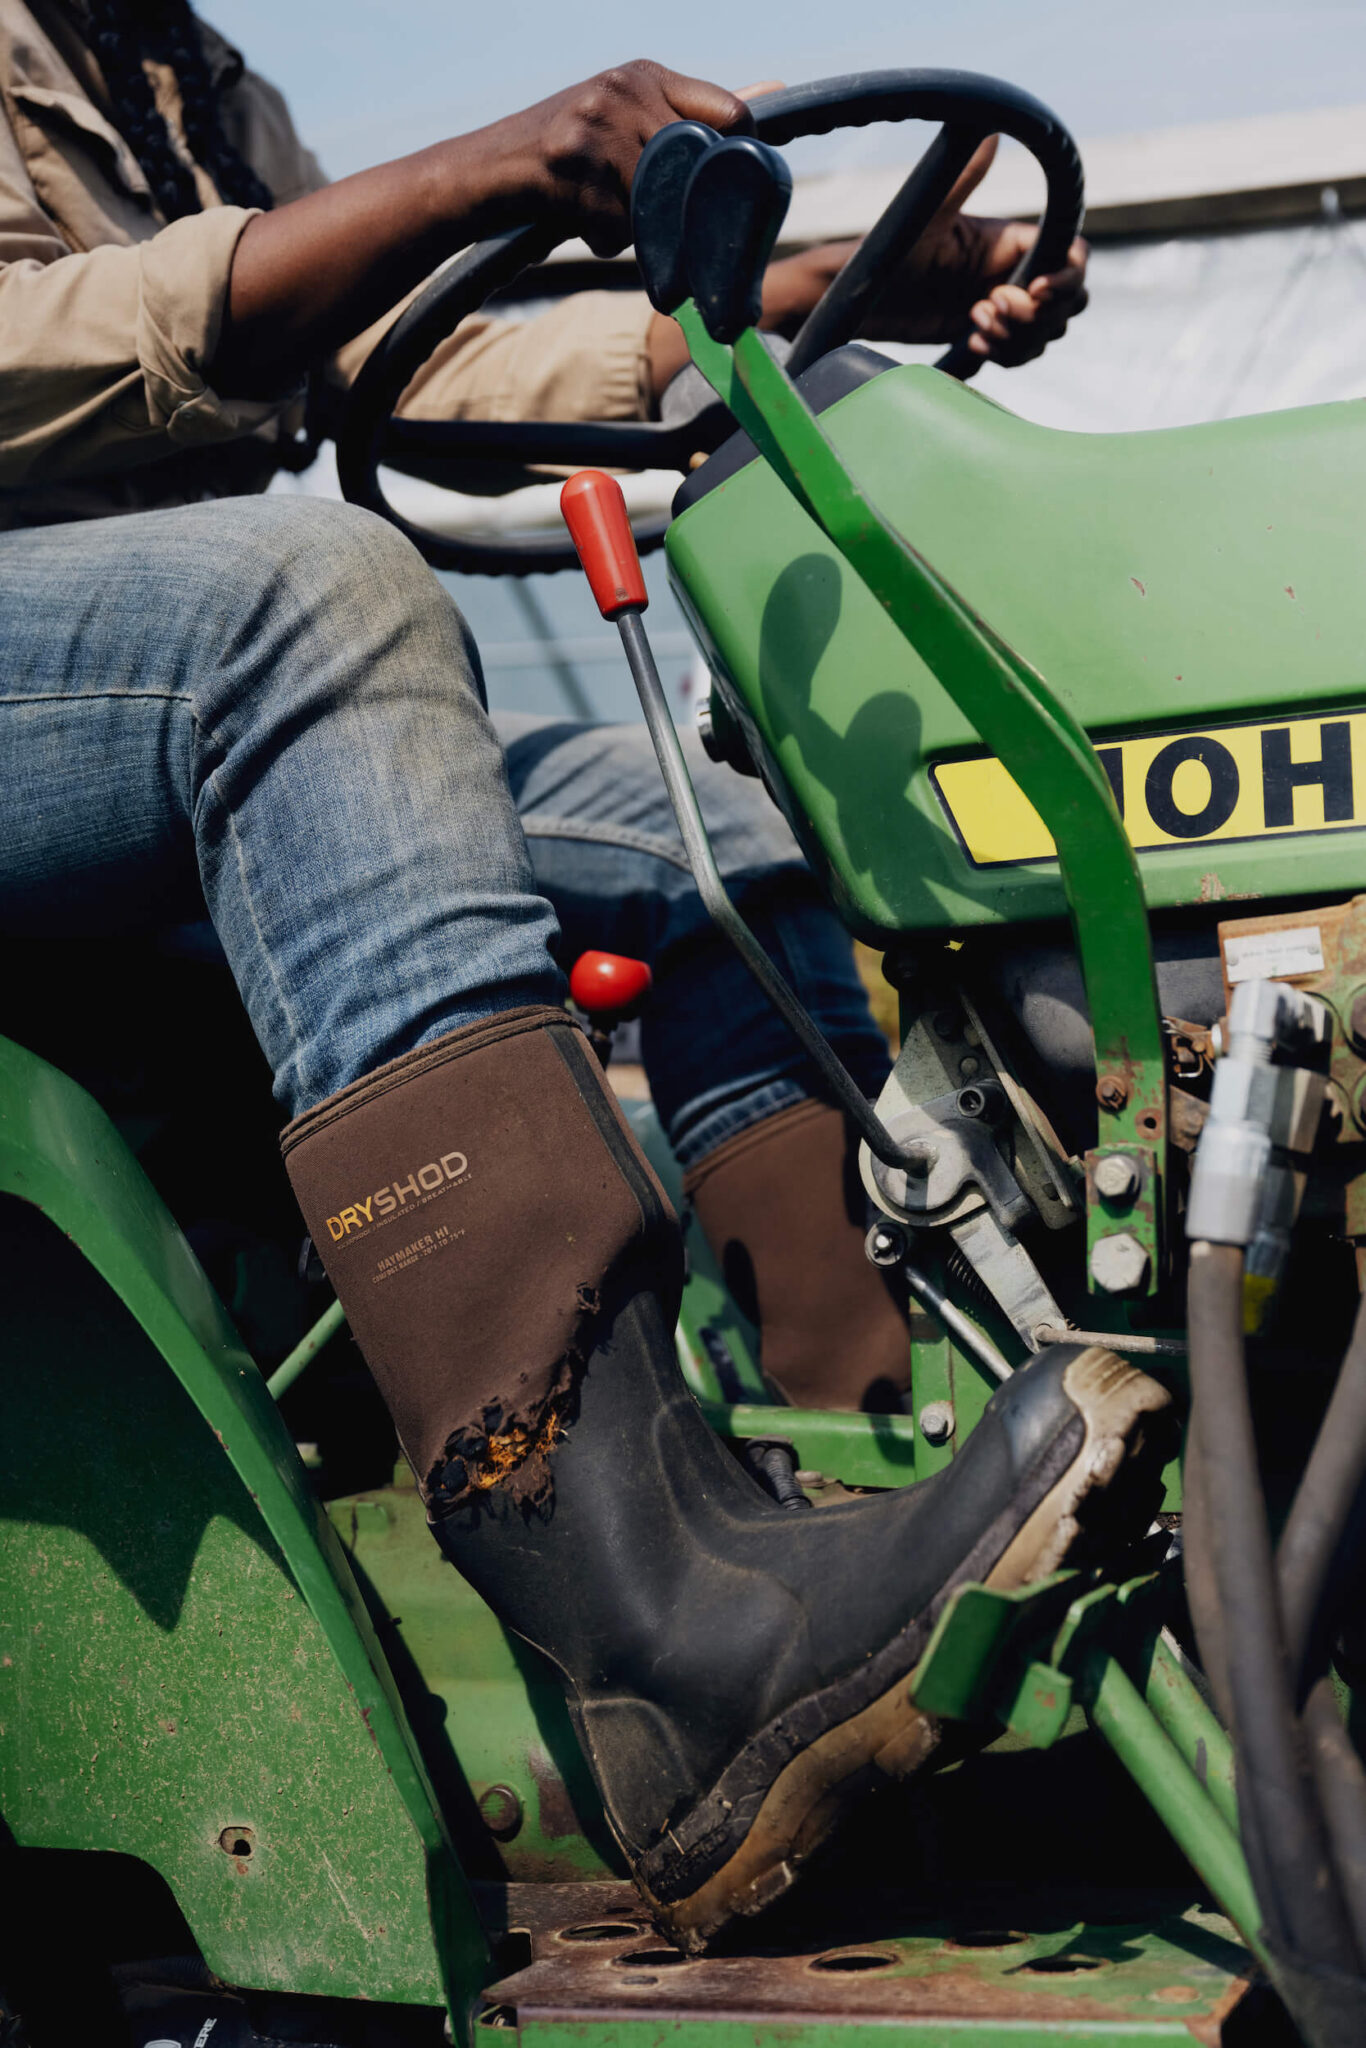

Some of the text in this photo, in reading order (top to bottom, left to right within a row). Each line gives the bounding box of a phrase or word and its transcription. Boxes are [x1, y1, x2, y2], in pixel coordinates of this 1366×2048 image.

[326, 1151, 468, 1242] DRYSHOD
[376, 1203, 416, 1229] INSULATED
[421, 1172, 473, 1204] BREATHABLE
[377, 1235, 434, 1272] HAYMAKER
[434, 1225, 450, 1240] HI
[193, 2018, 217, 2048] ERE
